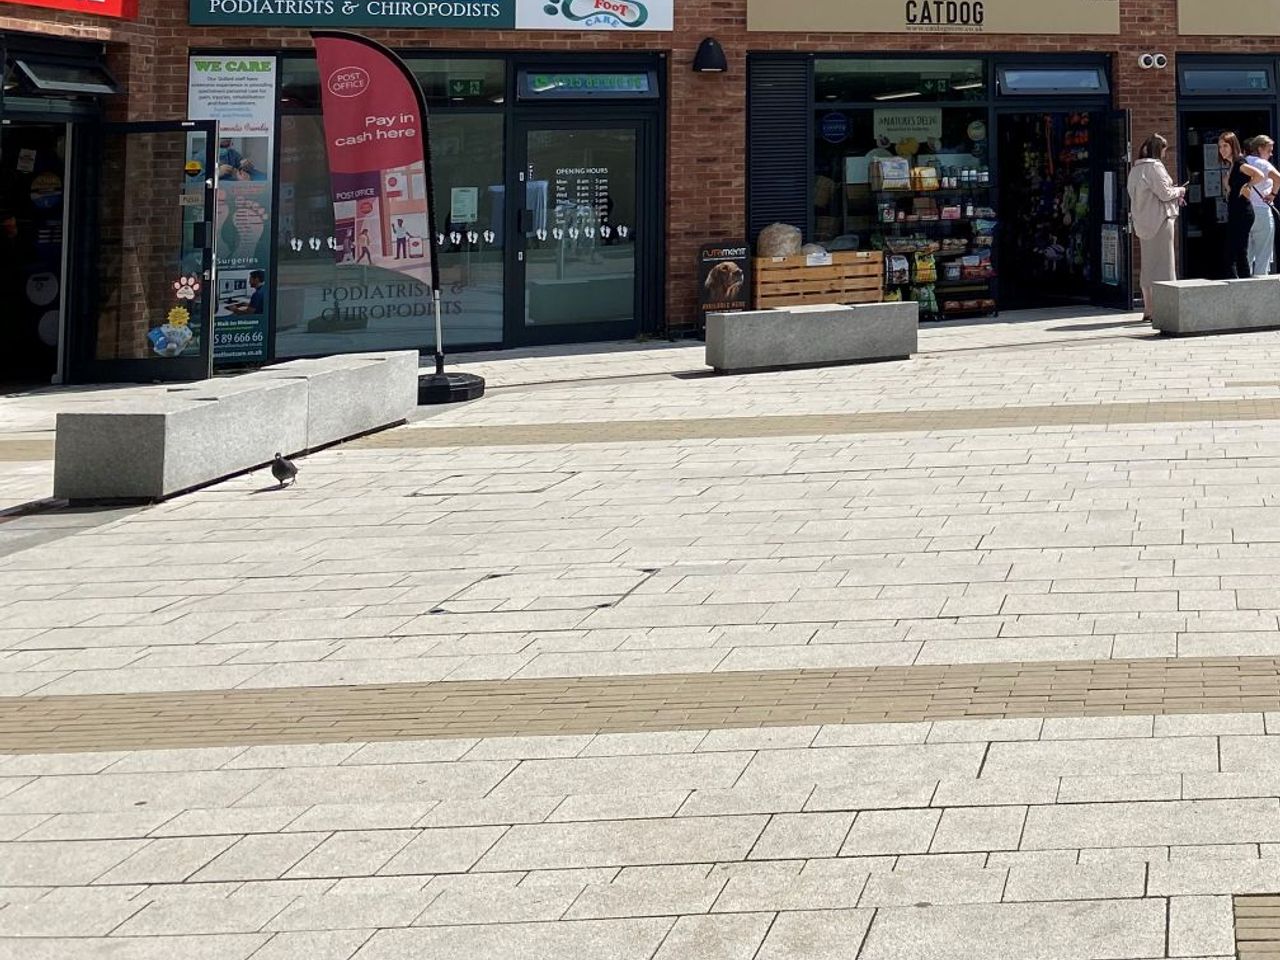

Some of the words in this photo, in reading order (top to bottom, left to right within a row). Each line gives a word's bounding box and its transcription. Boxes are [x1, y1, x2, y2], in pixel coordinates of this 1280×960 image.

[342, 1, 360, 15] &
[367, 1, 500, 17] CHIROPODISTS
[906, 0, 984, 24] CATDOG
[585, 16, 620, 28] CARE
[195, 61, 222, 71] WE
[225, 61, 271, 71] CARE
[337, 72, 361, 81] POST
[332, 80, 363, 91] OFFICE
[365, 116, 395, 127] Pay
[400, 113, 415, 123] in
[335, 132, 372, 146] cash
[376, 128, 415, 139] here
[336, 190, 354, 199] POST
[354, 188, 375, 196] OFFICE
[234, 332, 250, 343] 666
[252, 331, 263, 342] 66
